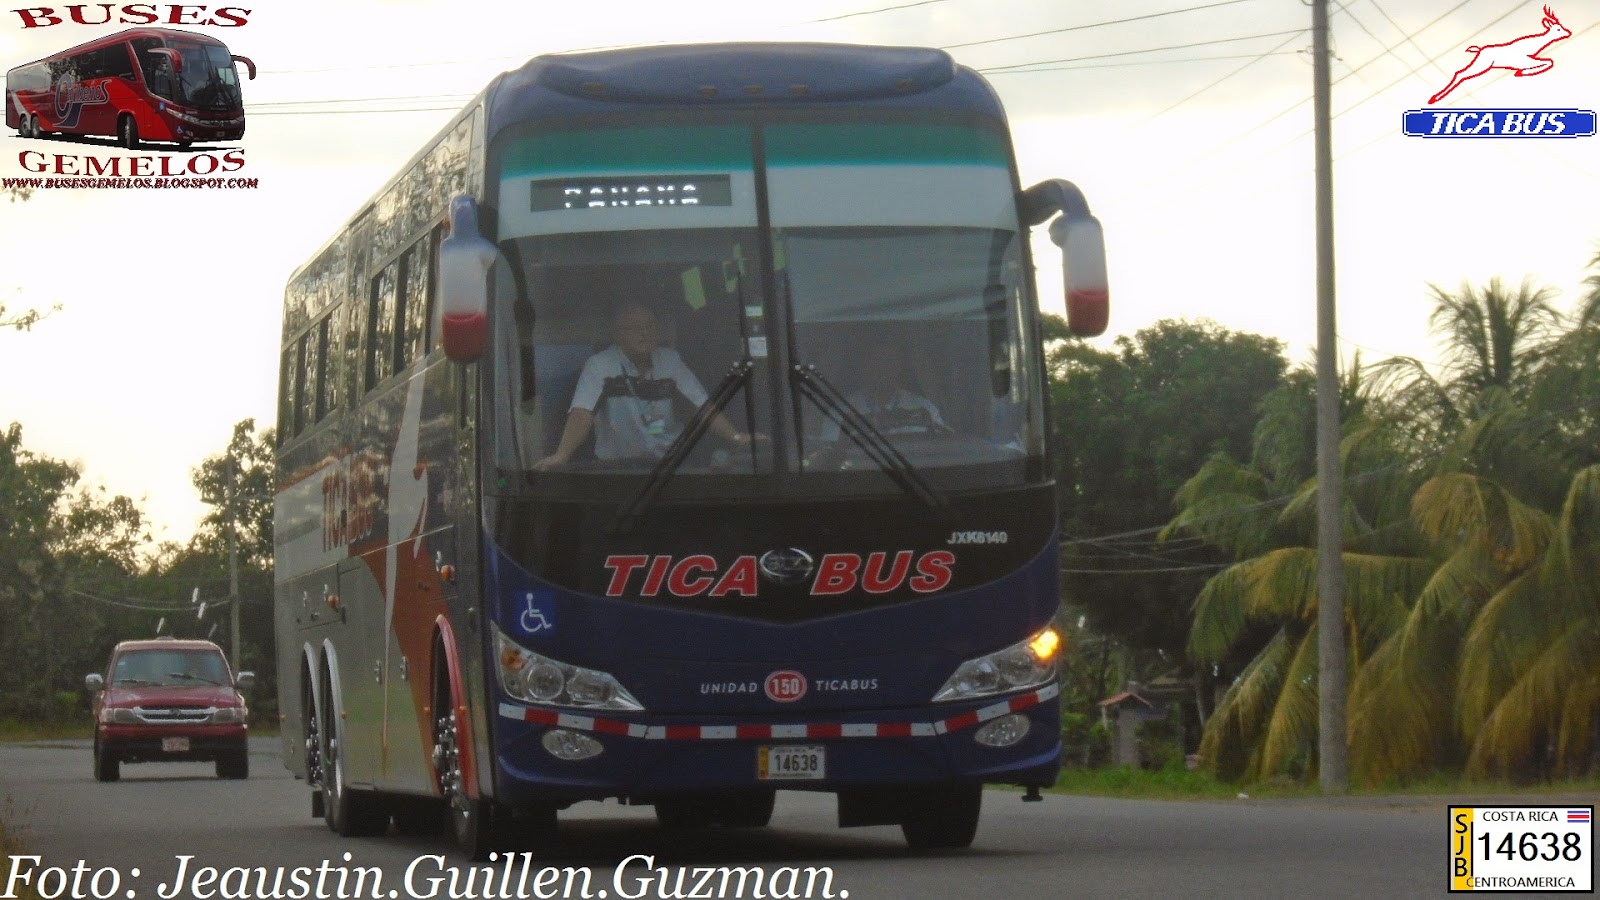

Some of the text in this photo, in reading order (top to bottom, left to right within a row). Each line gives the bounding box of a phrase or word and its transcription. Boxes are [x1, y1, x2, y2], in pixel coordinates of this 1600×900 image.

[564, 184, 699, 208] PANAMA
[604, 550, 955, 597] TICA BUS
[700, 678, 878, 695] UNIDAD 150 TICABUS
[775, 753, 818, 771] 14638
